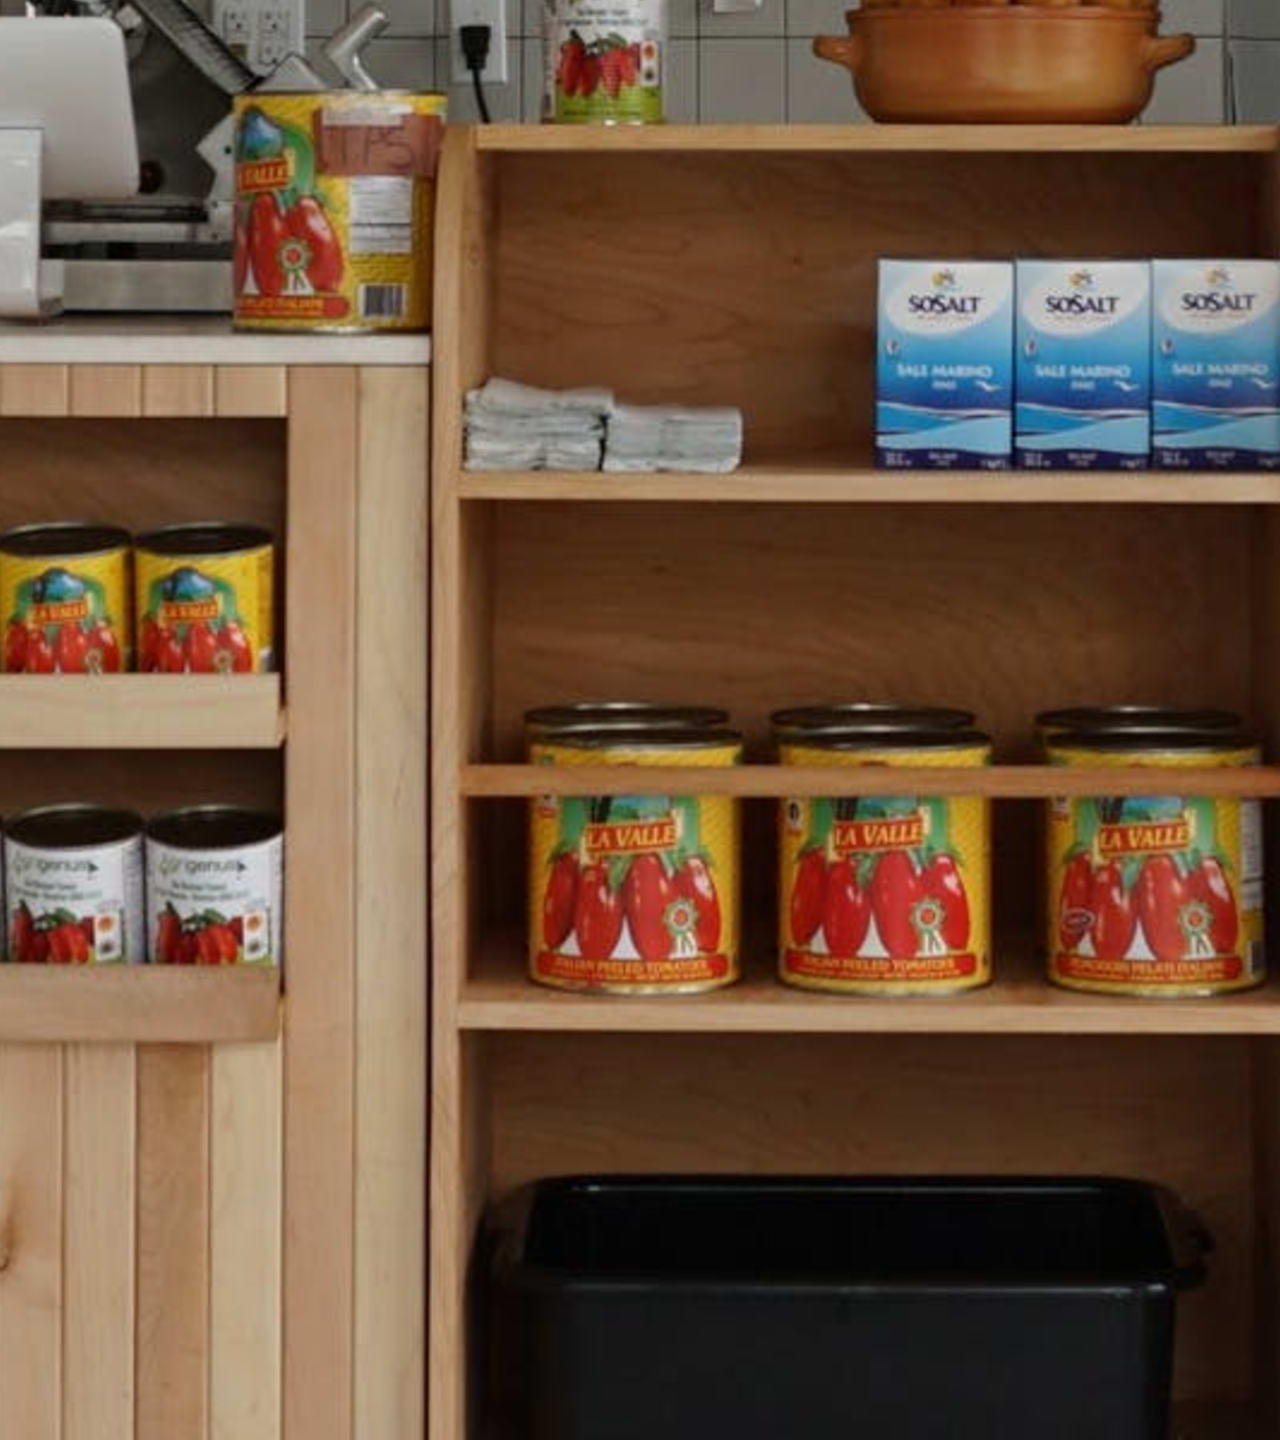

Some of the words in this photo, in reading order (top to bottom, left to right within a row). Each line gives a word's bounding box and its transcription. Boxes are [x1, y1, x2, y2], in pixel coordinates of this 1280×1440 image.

[897, 363, 928, 378] SALE
[931, 364, 994, 380] MARINO
[1035, 363, 1067, 378] SALE
[1070, 364, 1133, 378] MARINO
[1172, 363, 1202, 376] SALE
[1206, 362, 1271, 377] MARINO
[587, 827, 610, 849] LA
[614, 823, 676, 847] VALLE
[835, 825, 857, 847] LA
[862, 821, 922, 845] VALLE
[1099, 828, 1122, 849] LA
[1128, 824, 1189, 848] VALLE
